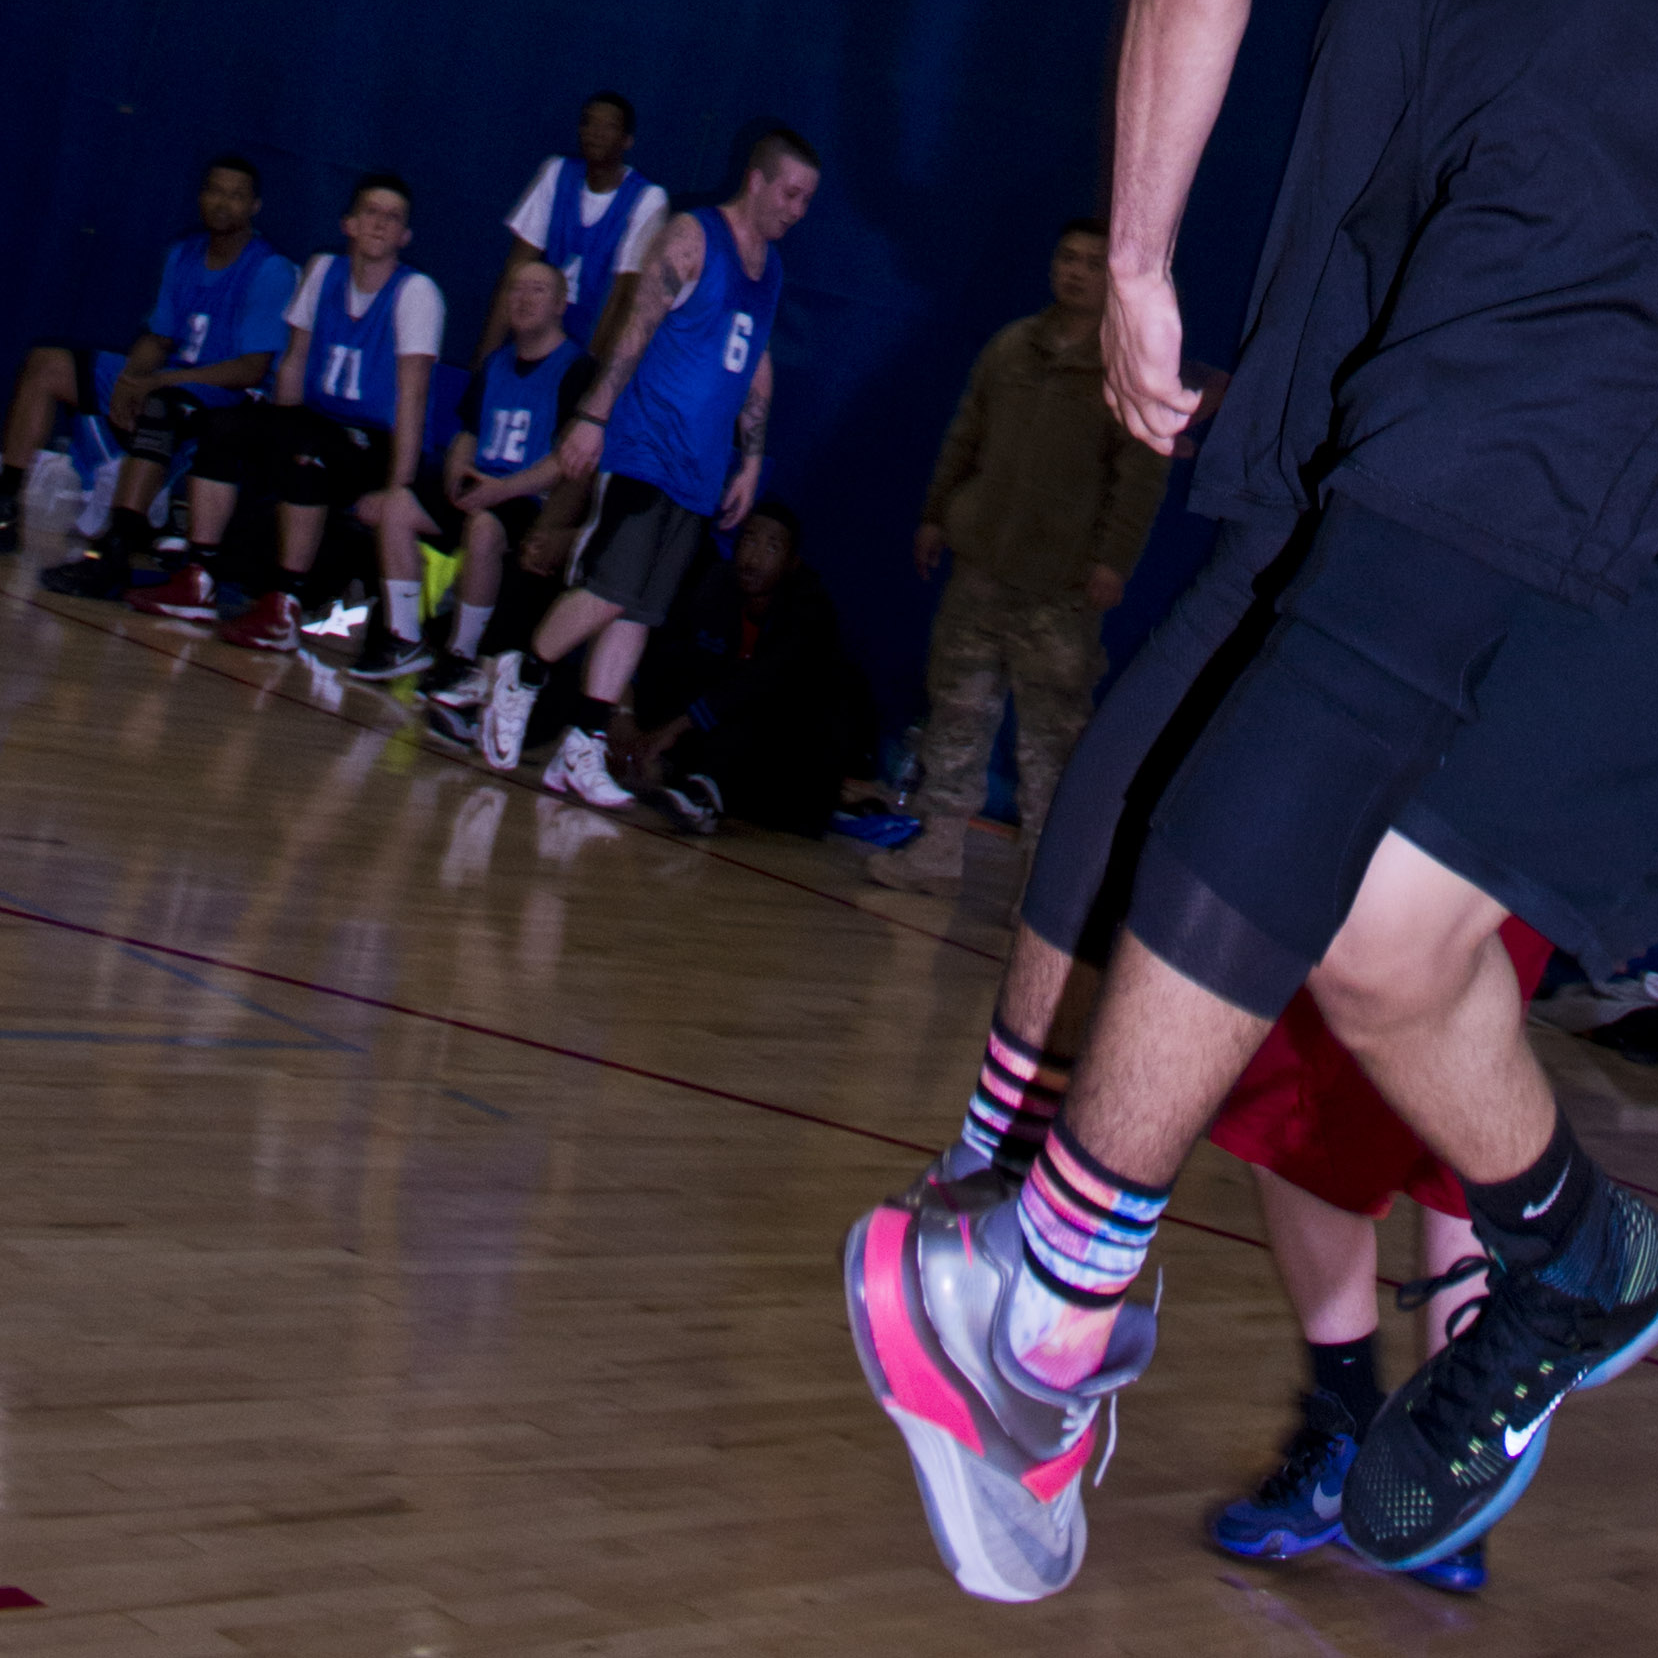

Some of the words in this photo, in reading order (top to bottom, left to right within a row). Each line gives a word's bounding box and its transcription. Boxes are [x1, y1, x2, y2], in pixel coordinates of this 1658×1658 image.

[723, 312, 753, 373] 6
[322, 344, 362, 400] 11
[482, 409, 532, 463] 12
